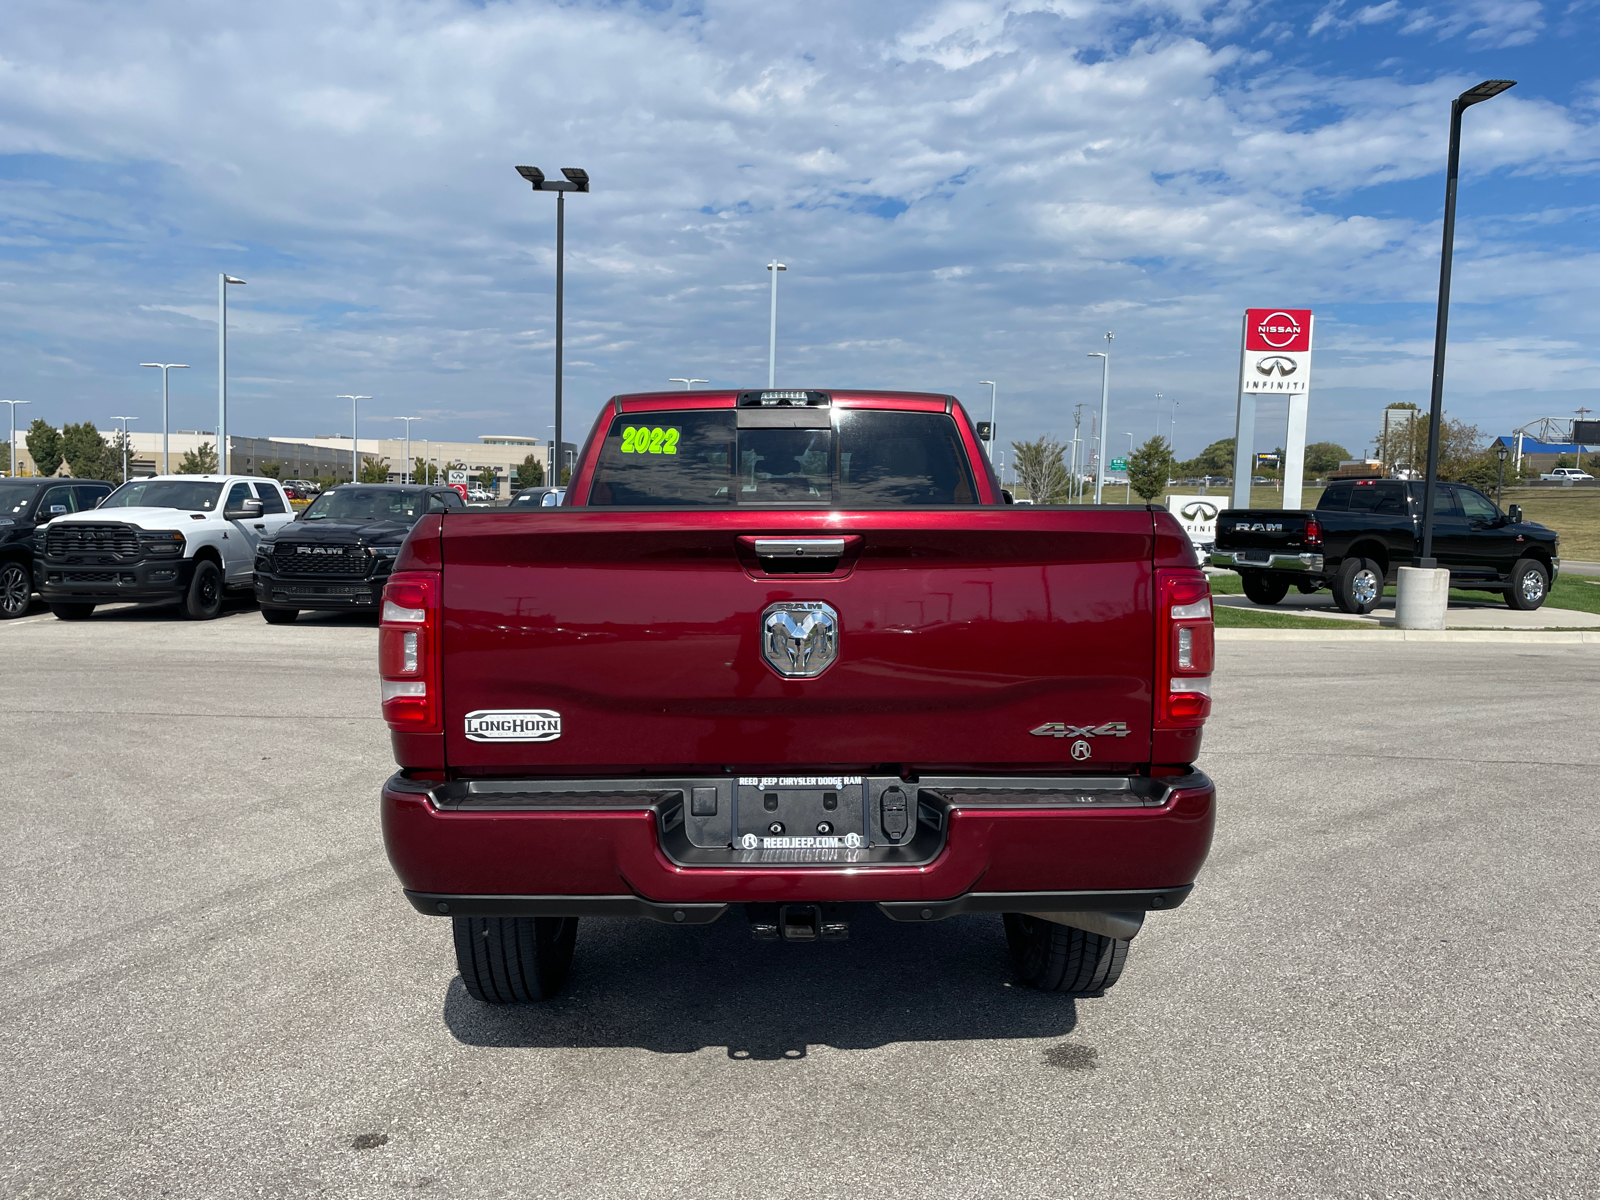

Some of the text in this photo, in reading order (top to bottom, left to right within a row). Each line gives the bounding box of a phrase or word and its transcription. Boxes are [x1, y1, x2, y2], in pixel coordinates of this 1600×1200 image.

[1246, 381, 1305, 389] INFINITI
[621, 426, 680, 454] 2022
[1235, 523, 1283, 532] RAM
[296, 547, 343, 555] RAM
[739, 776, 862, 786] REED JEEP CHRYSLER DODGE RAM
[763, 838, 838, 848] REEDJEEP.COM
